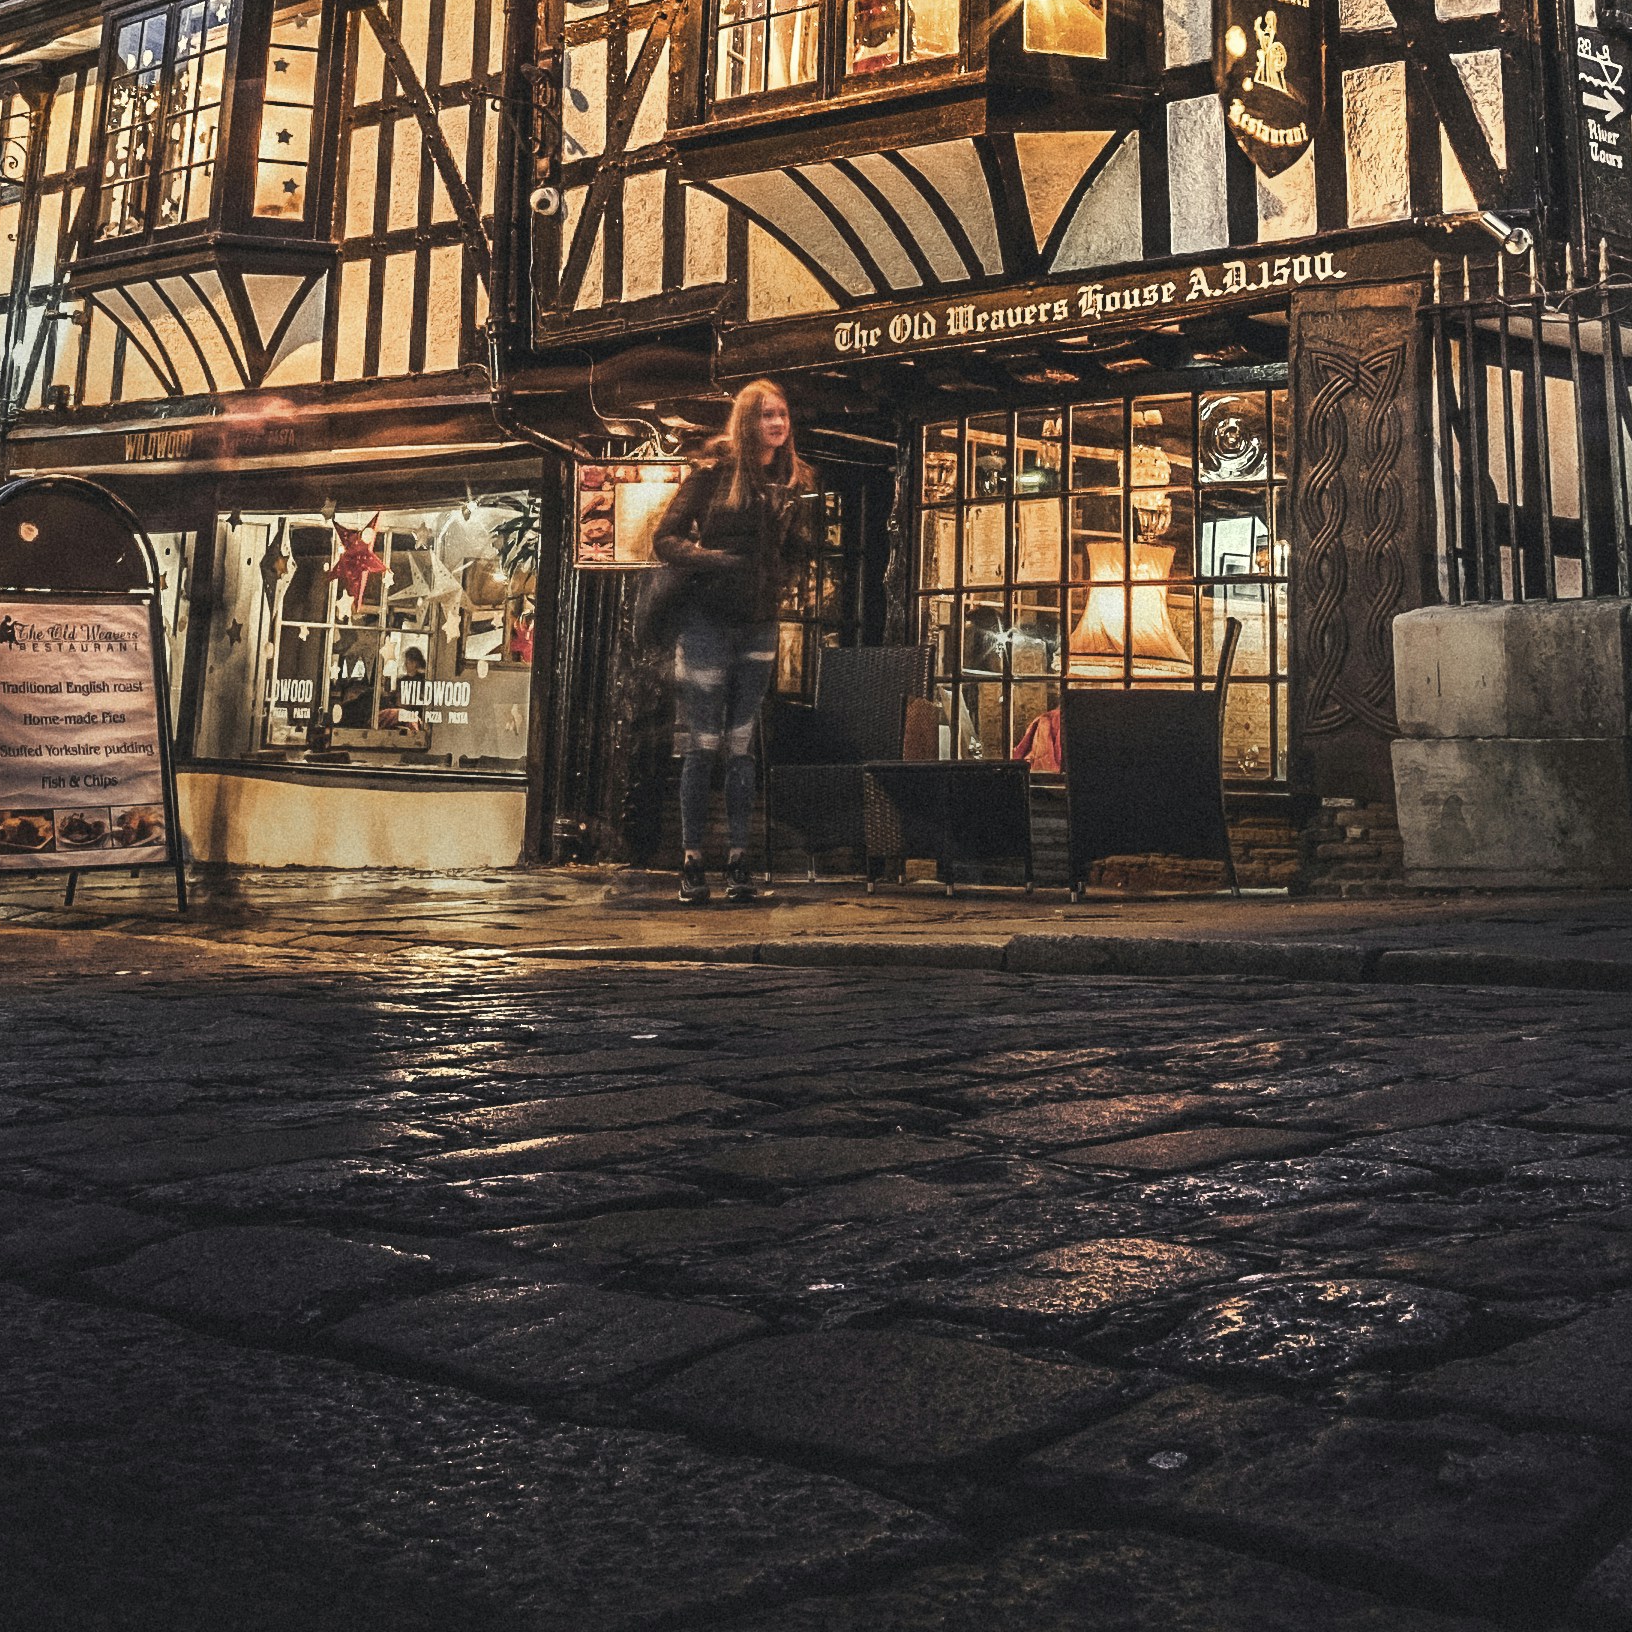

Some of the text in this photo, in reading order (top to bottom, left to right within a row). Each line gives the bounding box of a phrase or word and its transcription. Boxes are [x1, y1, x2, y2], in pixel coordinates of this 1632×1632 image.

[1229, 98, 1309, 146] Restaurant
[1588, 119, 1620, 146] River
[834, 321, 881, 353] The
[888, 311, 937, 344] Old
[946, 298, 1068, 336] Weavers
[1077, 281, 1176, 319] House
[125, 429, 193, 461] WILDWOOD
[16, 623, 139, 640] The Old Weavers
[18, 642, 139, 653] RESTAURANT
[0, 680, 144, 696] Traditional English roast
[264, 678, 314, 703] LDWOOD
[400, 680, 471, 707] WILDWOOD
[23, 711, 126, 726] Home-made Pies
[448, 711, 468, 724] PASTA
[0, 741, 155, 758] Stuffed Yorkshire pudding
[41, 773, 119, 789] Fish & Chips
